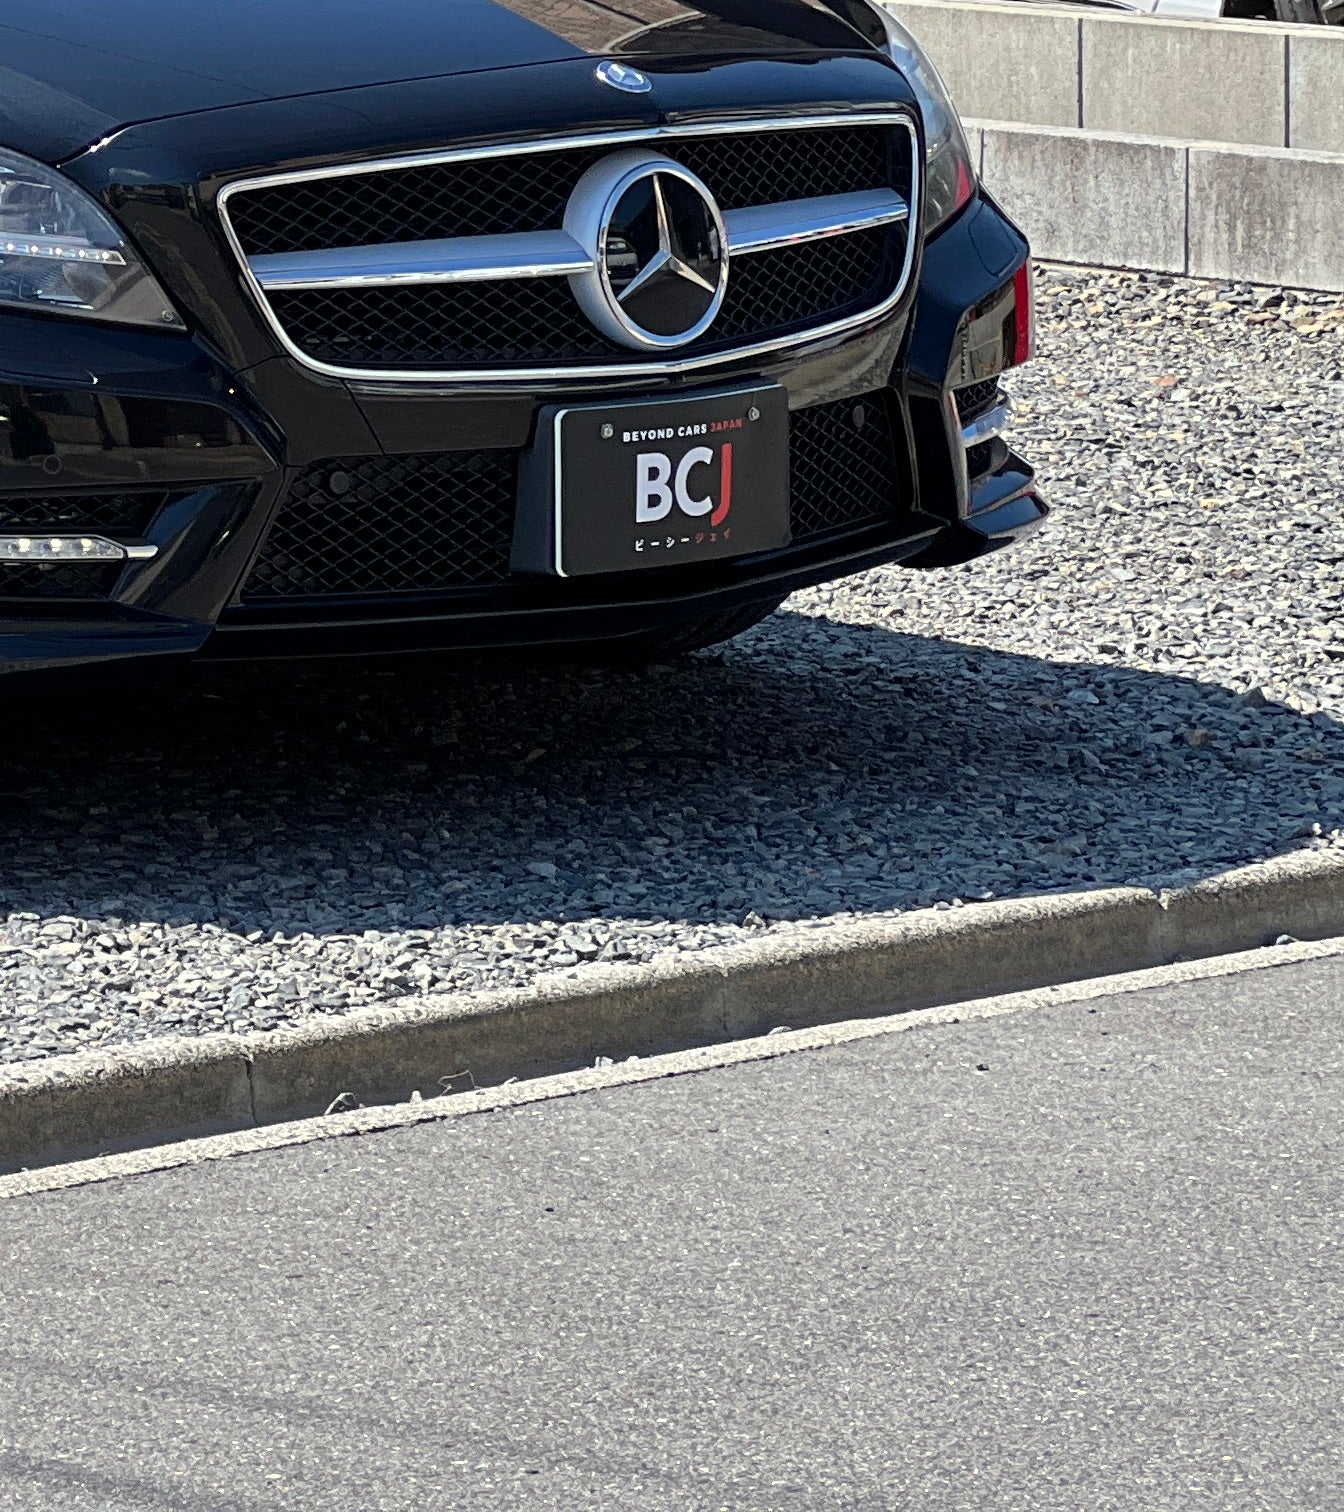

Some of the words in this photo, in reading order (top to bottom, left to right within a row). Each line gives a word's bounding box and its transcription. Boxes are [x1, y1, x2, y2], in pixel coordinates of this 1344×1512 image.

[623, 428, 674, 443] BEYOND
[678, 424, 707, 438] CARS
[711, 419, 743, 433] JAPAN
[636, 442, 732, 527] BCJ
